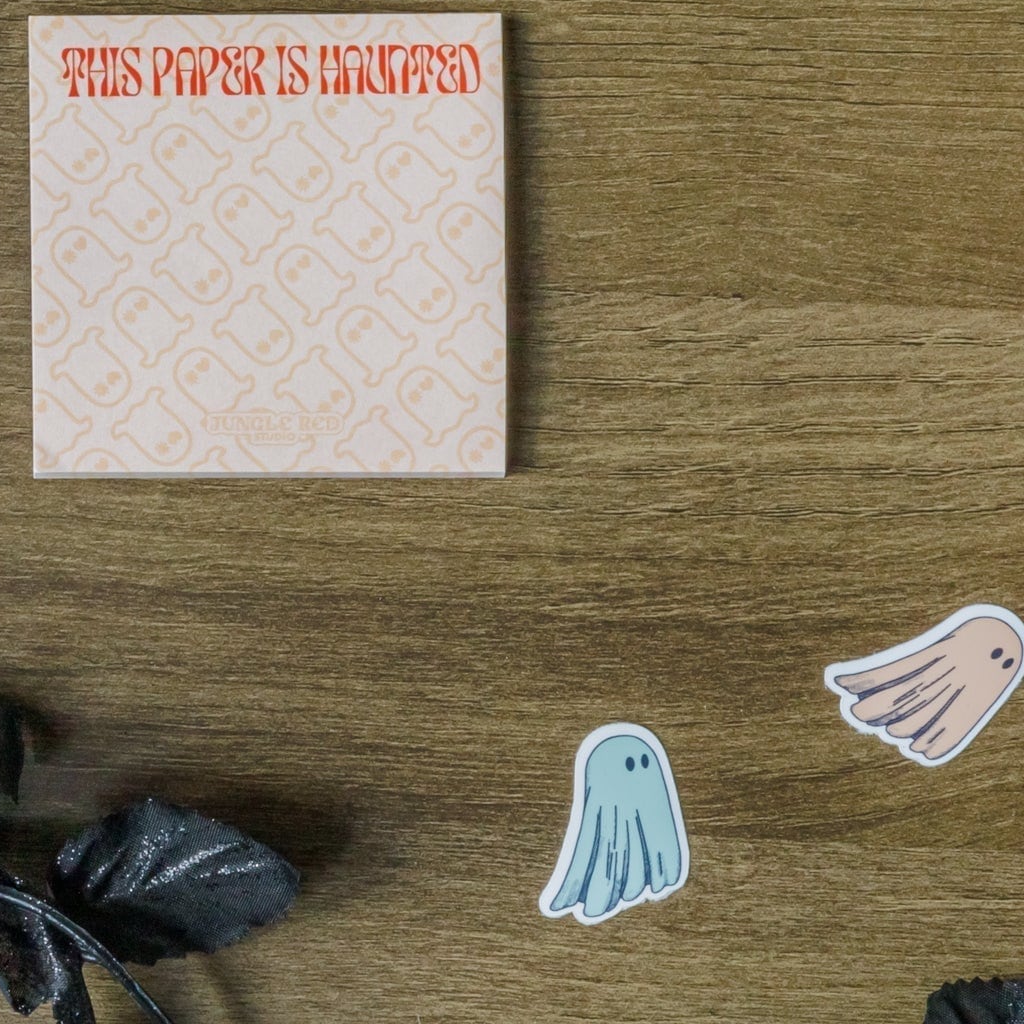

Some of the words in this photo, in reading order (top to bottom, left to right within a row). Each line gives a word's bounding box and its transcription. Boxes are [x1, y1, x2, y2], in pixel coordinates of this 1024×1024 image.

[60, 46, 142, 97] THIS
[152, 45, 266, 96] PAPER
[275, 44, 310, 95] IS
[318, 43, 482, 95] HAUNTED
[210, 416, 292, 432] JUNGLE
[299, 416, 339, 432] RED
